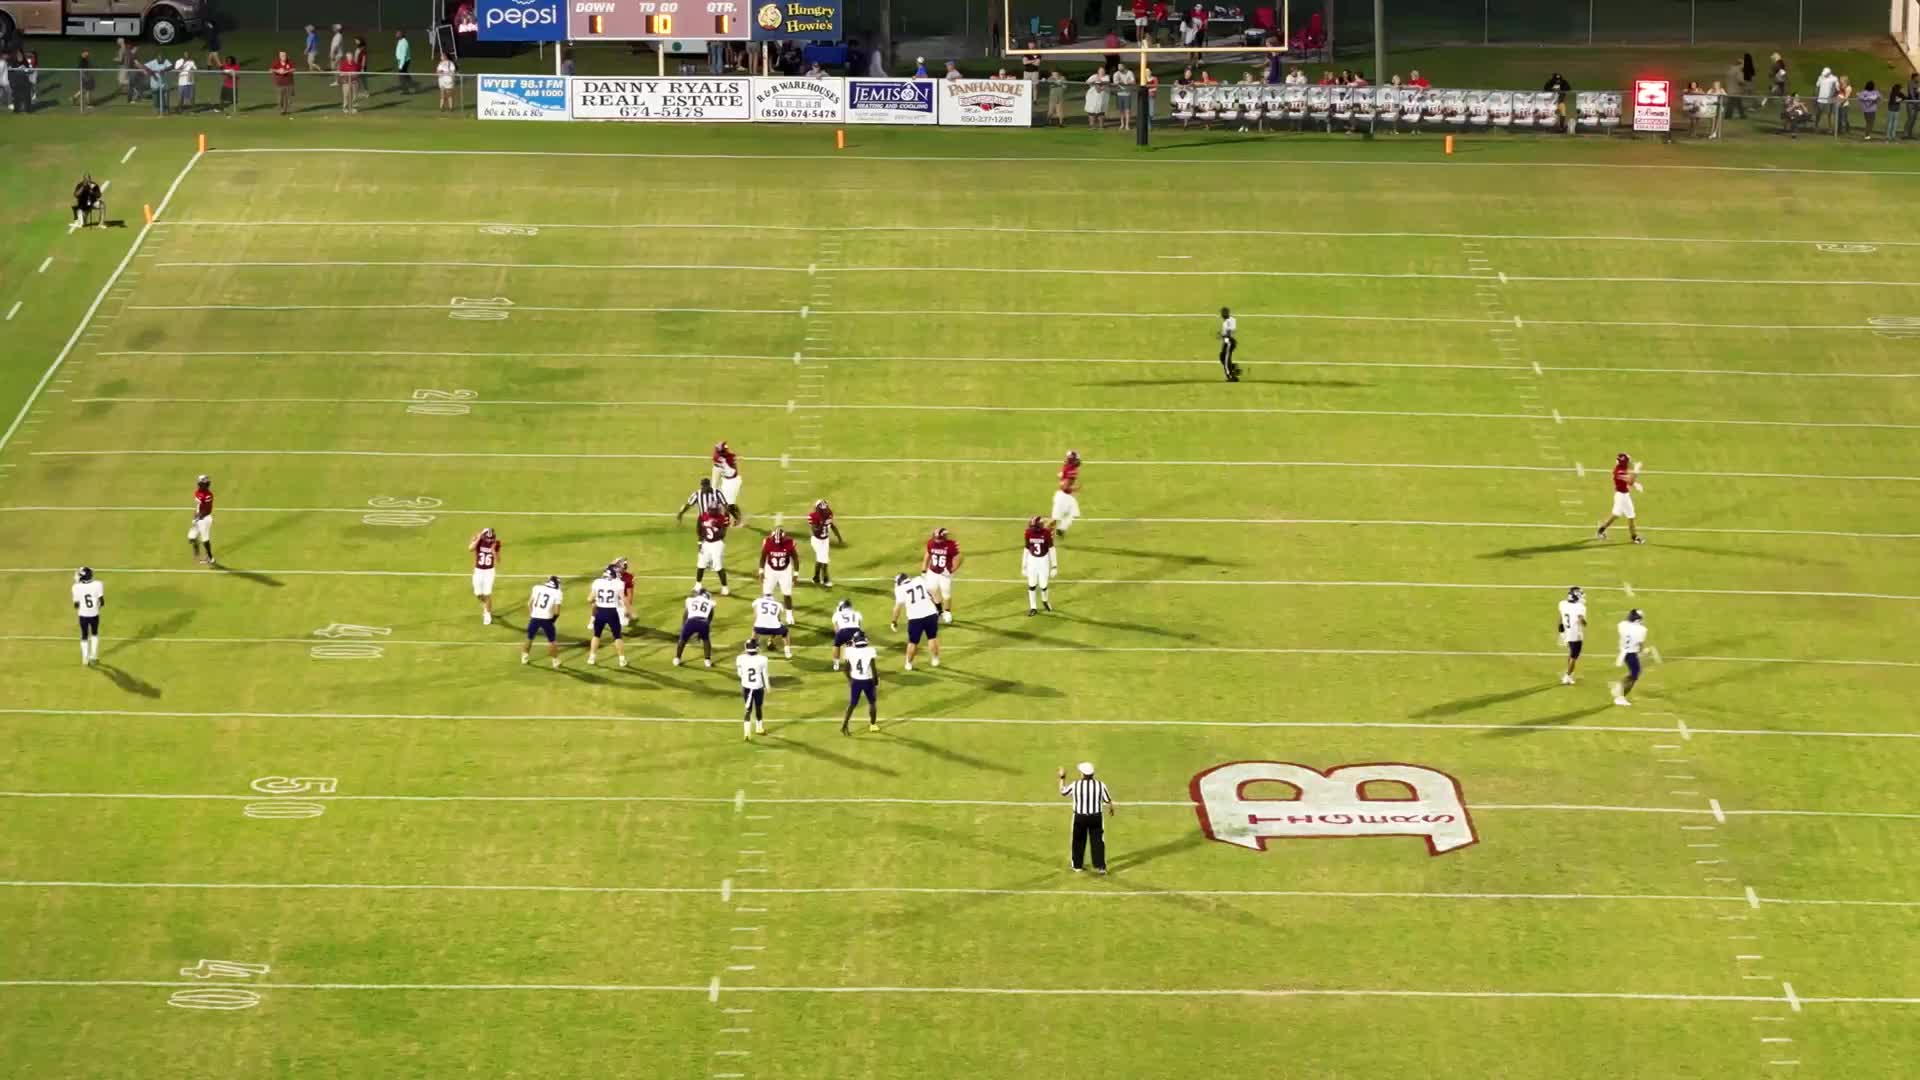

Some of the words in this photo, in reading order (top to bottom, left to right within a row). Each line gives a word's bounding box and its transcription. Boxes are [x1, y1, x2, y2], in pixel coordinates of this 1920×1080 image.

[576, 3, 615, 12] DOWN
[639, 3, 655, 12] TO
[660, 3, 679, 12] GO
[707, 3, 737, 12] QTR.
[786, 3, 834, 17] Hungry
[486, 4, 557, 29] pepsi
[653, 14, 672, 34] 10
[786, 19, 833, 33] Howie's
[520, 80, 543, 88] 98.1
[546, 80, 563, 89] FM
[584, 82, 658, 94] DANNY
[670, 82, 739, 94] RYALS
[947, 81, 1025, 97] PANHANDLE
[756, 95, 764, 103] R
[770, 85, 780, 94] R
[779, 80, 840, 105] WAREHOUSES
[853, 85, 930, 105] JEMISON
[582, 95, 646, 107] REAL
[662, 95, 743, 107] ESTATE
[619, 106, 704, 118] 674-5478
[761, 109, 788, 118] (850)
[791, 109, 836, 119] 674-5478
[362, 496, 443, 526] 30
[1033, 543, 1041, 555] 3
[478, 553, 492, 566] 36
[84, 594, 93, 608] 6
[535, 591, 550, 608] 13
[906, 585, 926, 604] 77
[761, 602, 778, 615] 53
[842, 614, 855, 623] 51
[310, 623, 393, 659] 40
[856, 659, 863, 675] 4
[748, 668, 756, 682] 2
[243, 775, 338, 819] 50
[167, 959, 271, 1011] 40
